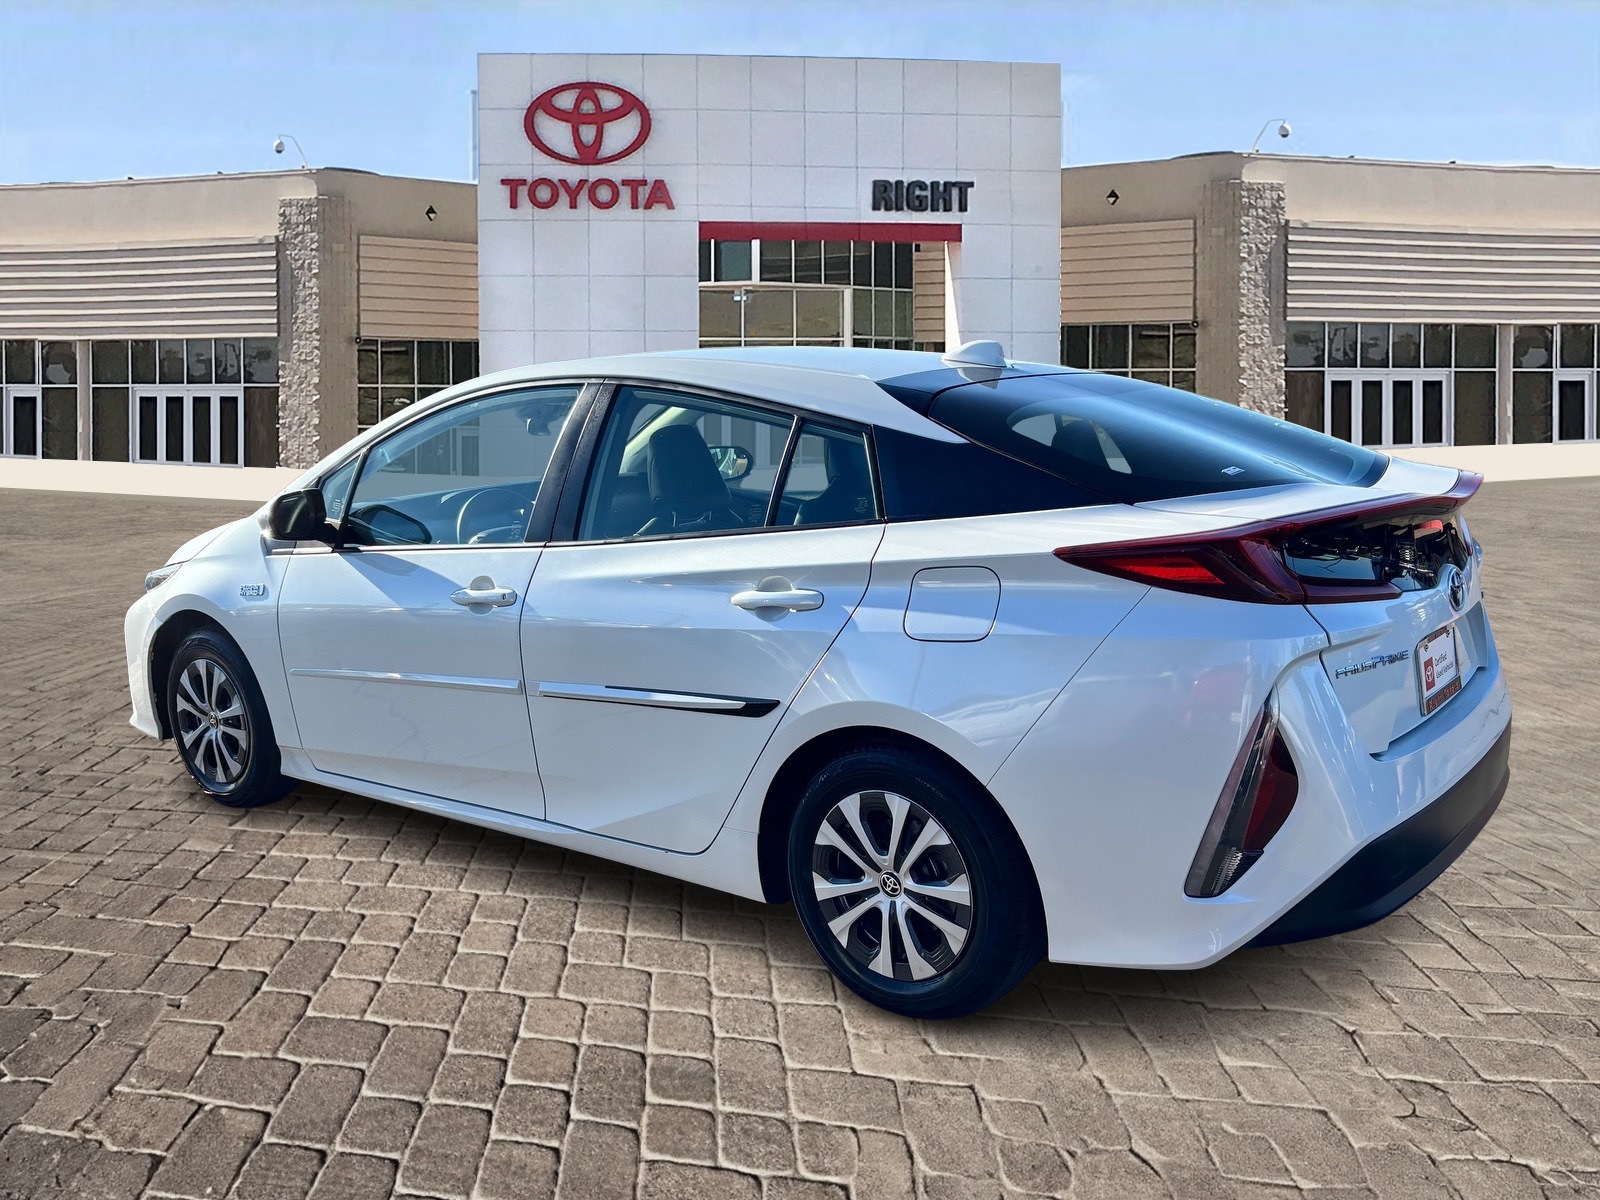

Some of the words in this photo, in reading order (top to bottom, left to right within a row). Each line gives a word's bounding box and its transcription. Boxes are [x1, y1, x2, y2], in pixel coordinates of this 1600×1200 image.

[500, 177, 675, 210] TOYOTA
[872, 179, 975, 212] RIGHT
[1335, 660, 1373, 679] PRIUS
[1372, 650, 1410, 669] PRIME
